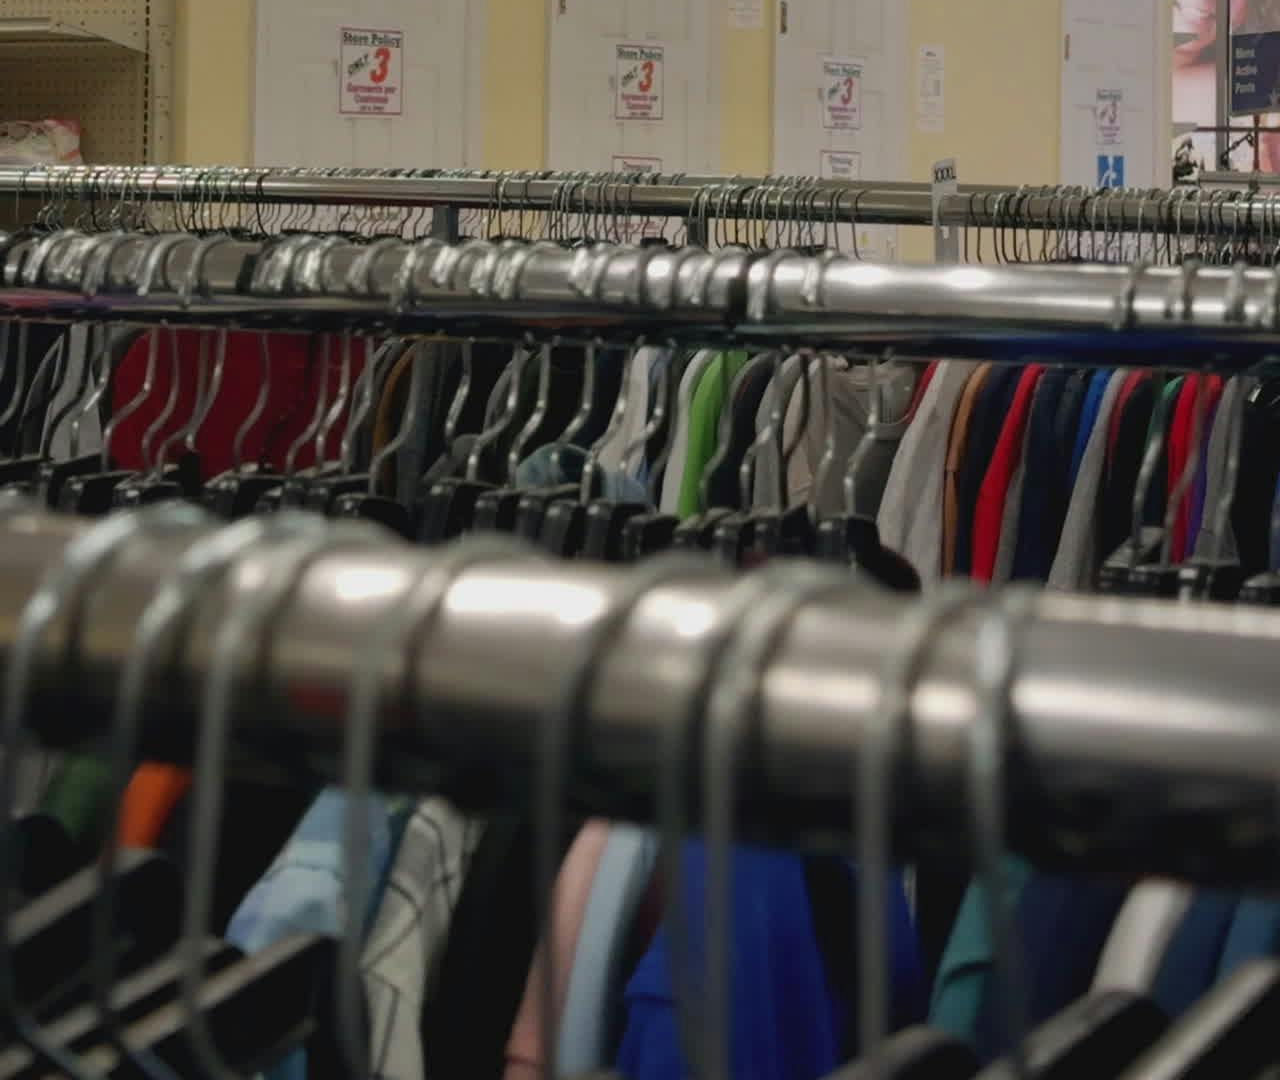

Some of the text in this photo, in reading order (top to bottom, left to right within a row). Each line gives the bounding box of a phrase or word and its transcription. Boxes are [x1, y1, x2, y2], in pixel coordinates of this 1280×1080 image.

[343, 31, 401, 49] Store Policy
[370, 46, 391, 84] 3
[638, 60, 655, 92] 3
[841, 77, 854, 104] 3
